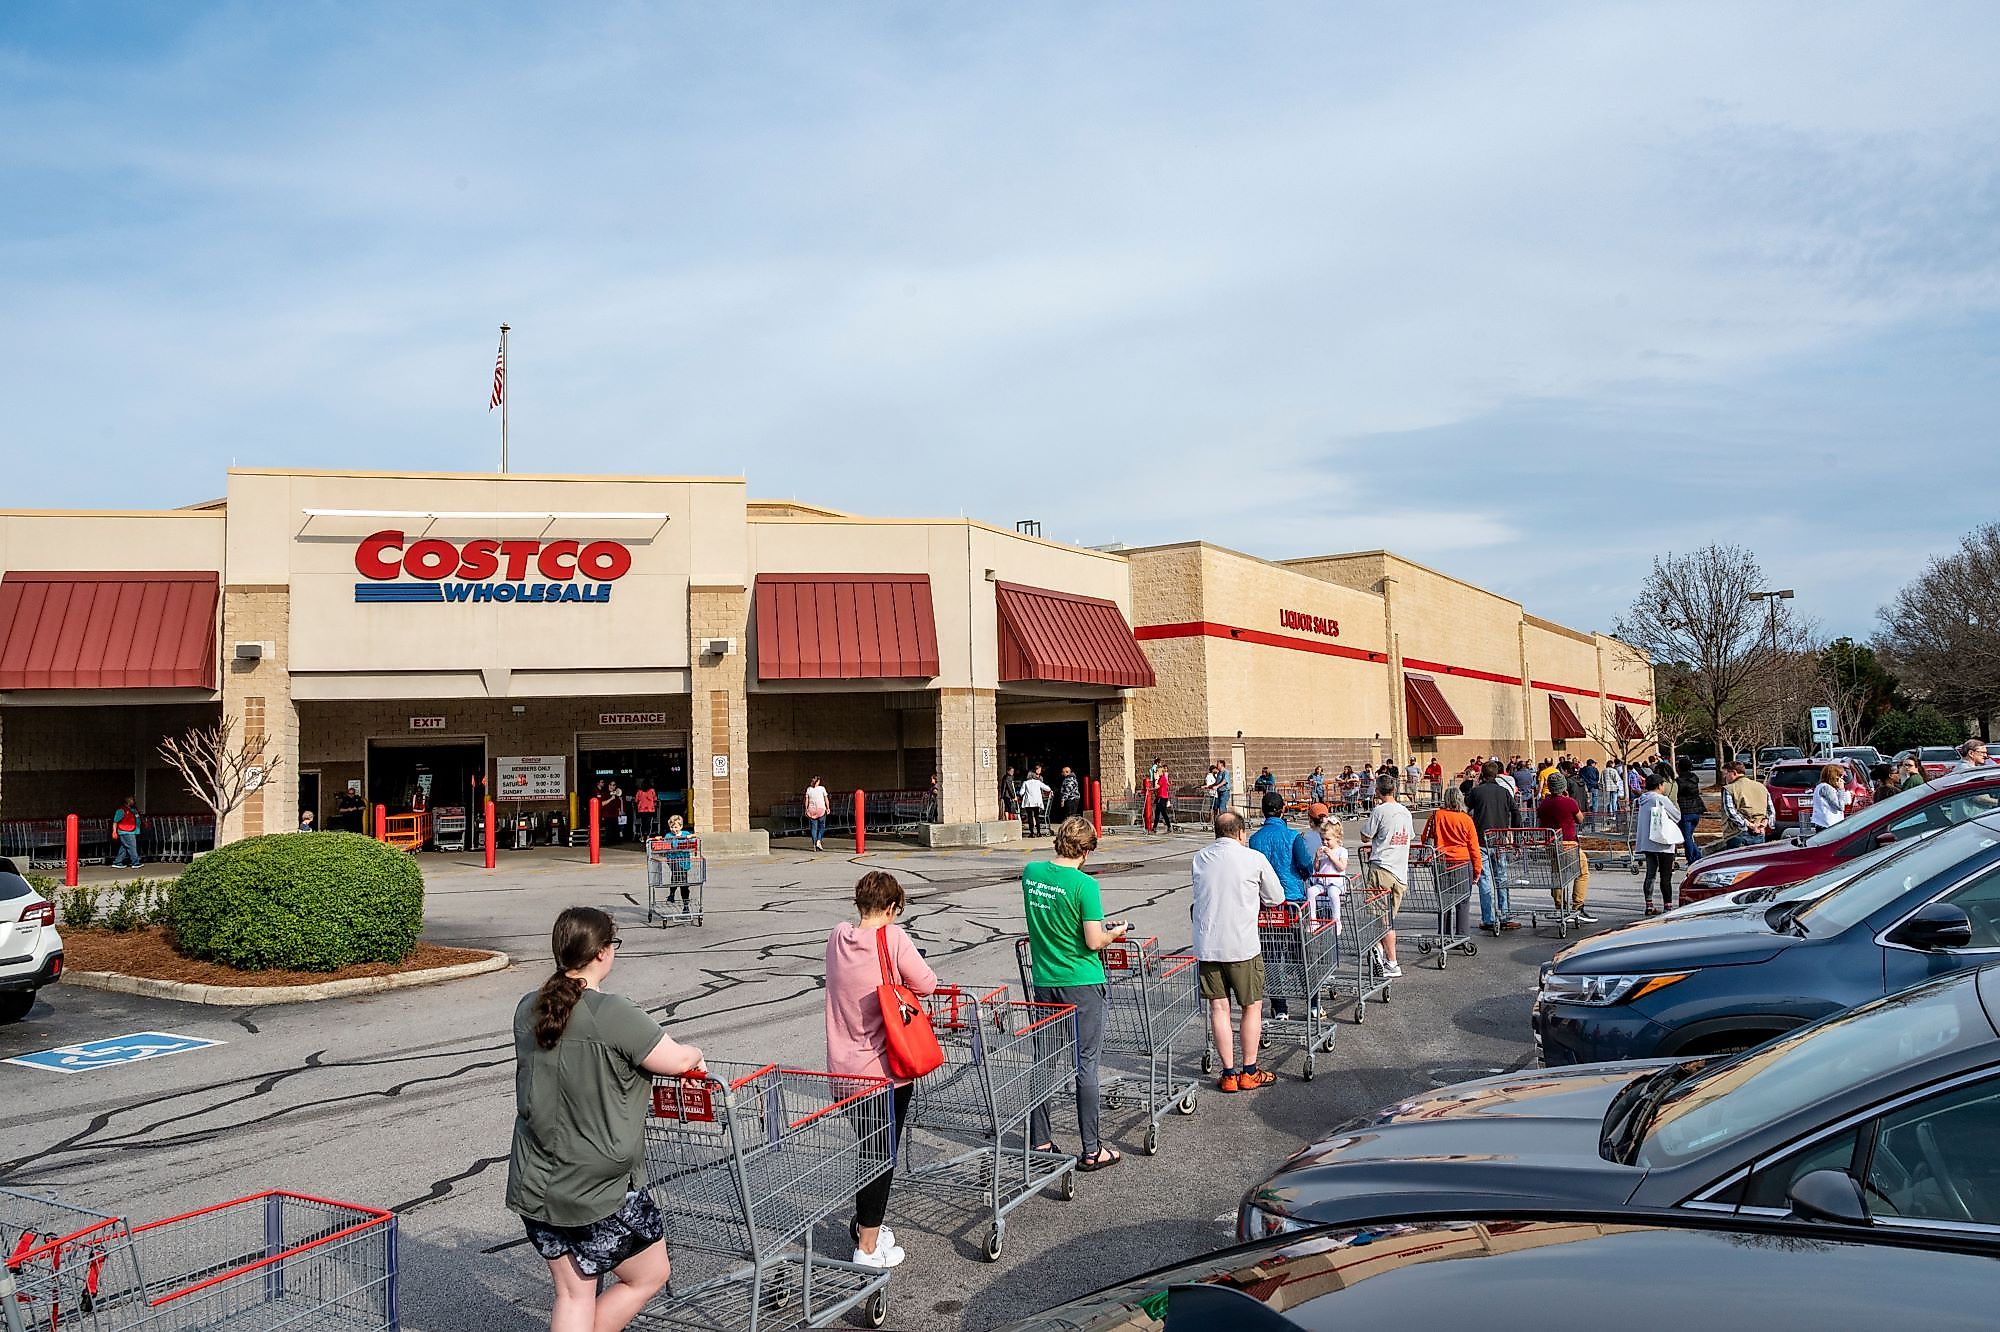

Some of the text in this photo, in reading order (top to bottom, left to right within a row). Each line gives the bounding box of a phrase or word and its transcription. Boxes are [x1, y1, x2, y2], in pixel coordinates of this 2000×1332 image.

[355, 530, 632, 581] COSTCO
[443, 583, 612, 603] WHOLESALE
[1280, 609, 1339, 637] LIQUOR SALES
[413, 718, 442, 727] EXIT
[601, 714, 664, 723] ENTRANCE
